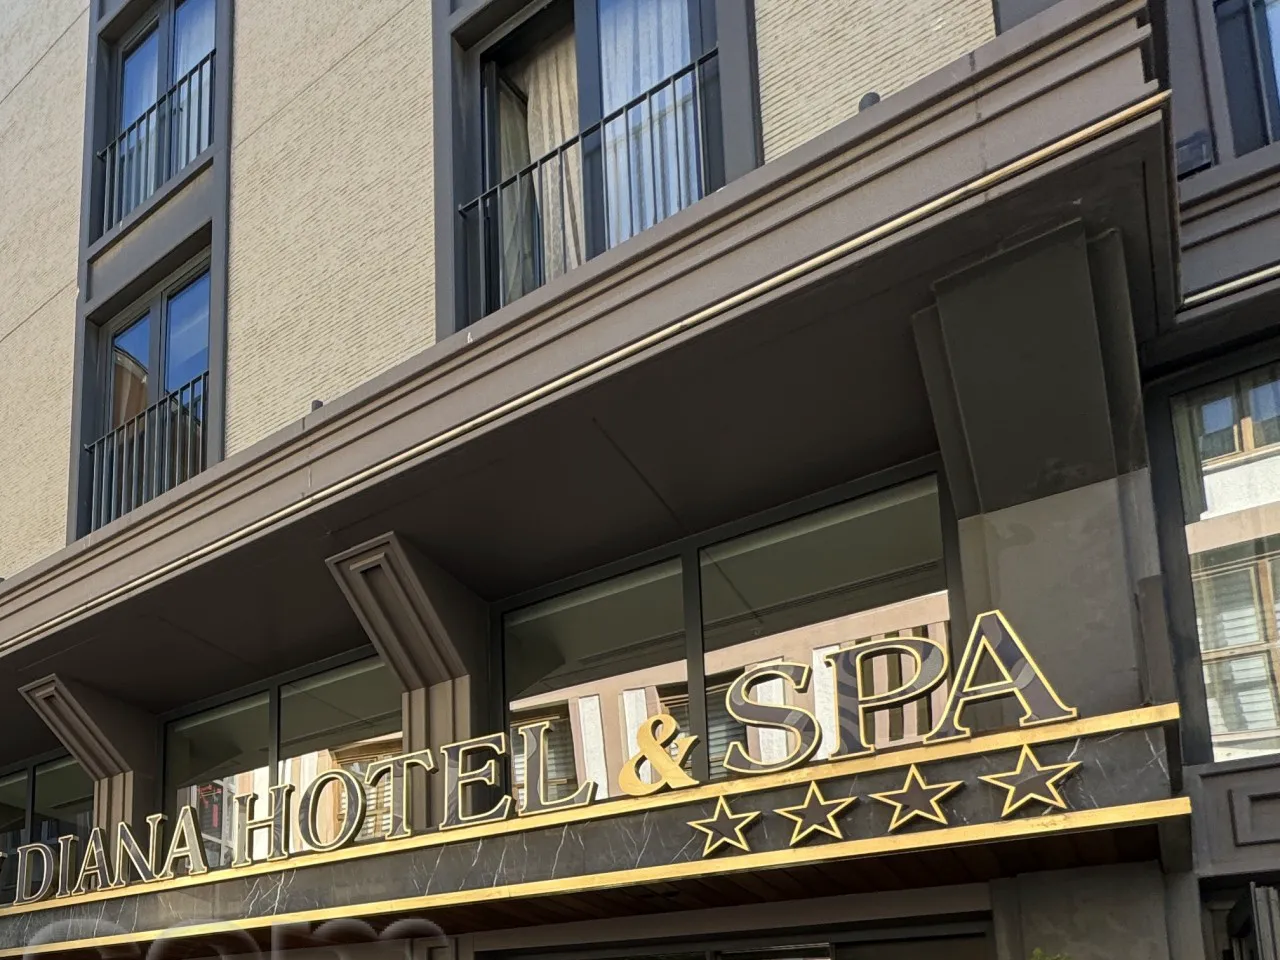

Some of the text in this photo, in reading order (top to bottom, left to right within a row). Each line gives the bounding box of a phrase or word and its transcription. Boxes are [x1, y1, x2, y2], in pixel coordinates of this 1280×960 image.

[12, 805, 208, 905] DIANA
[233, 720, 597, 867] HOTEL
[617, 713, 700, 796] &
[723, 609, 1077, 774] SPA
